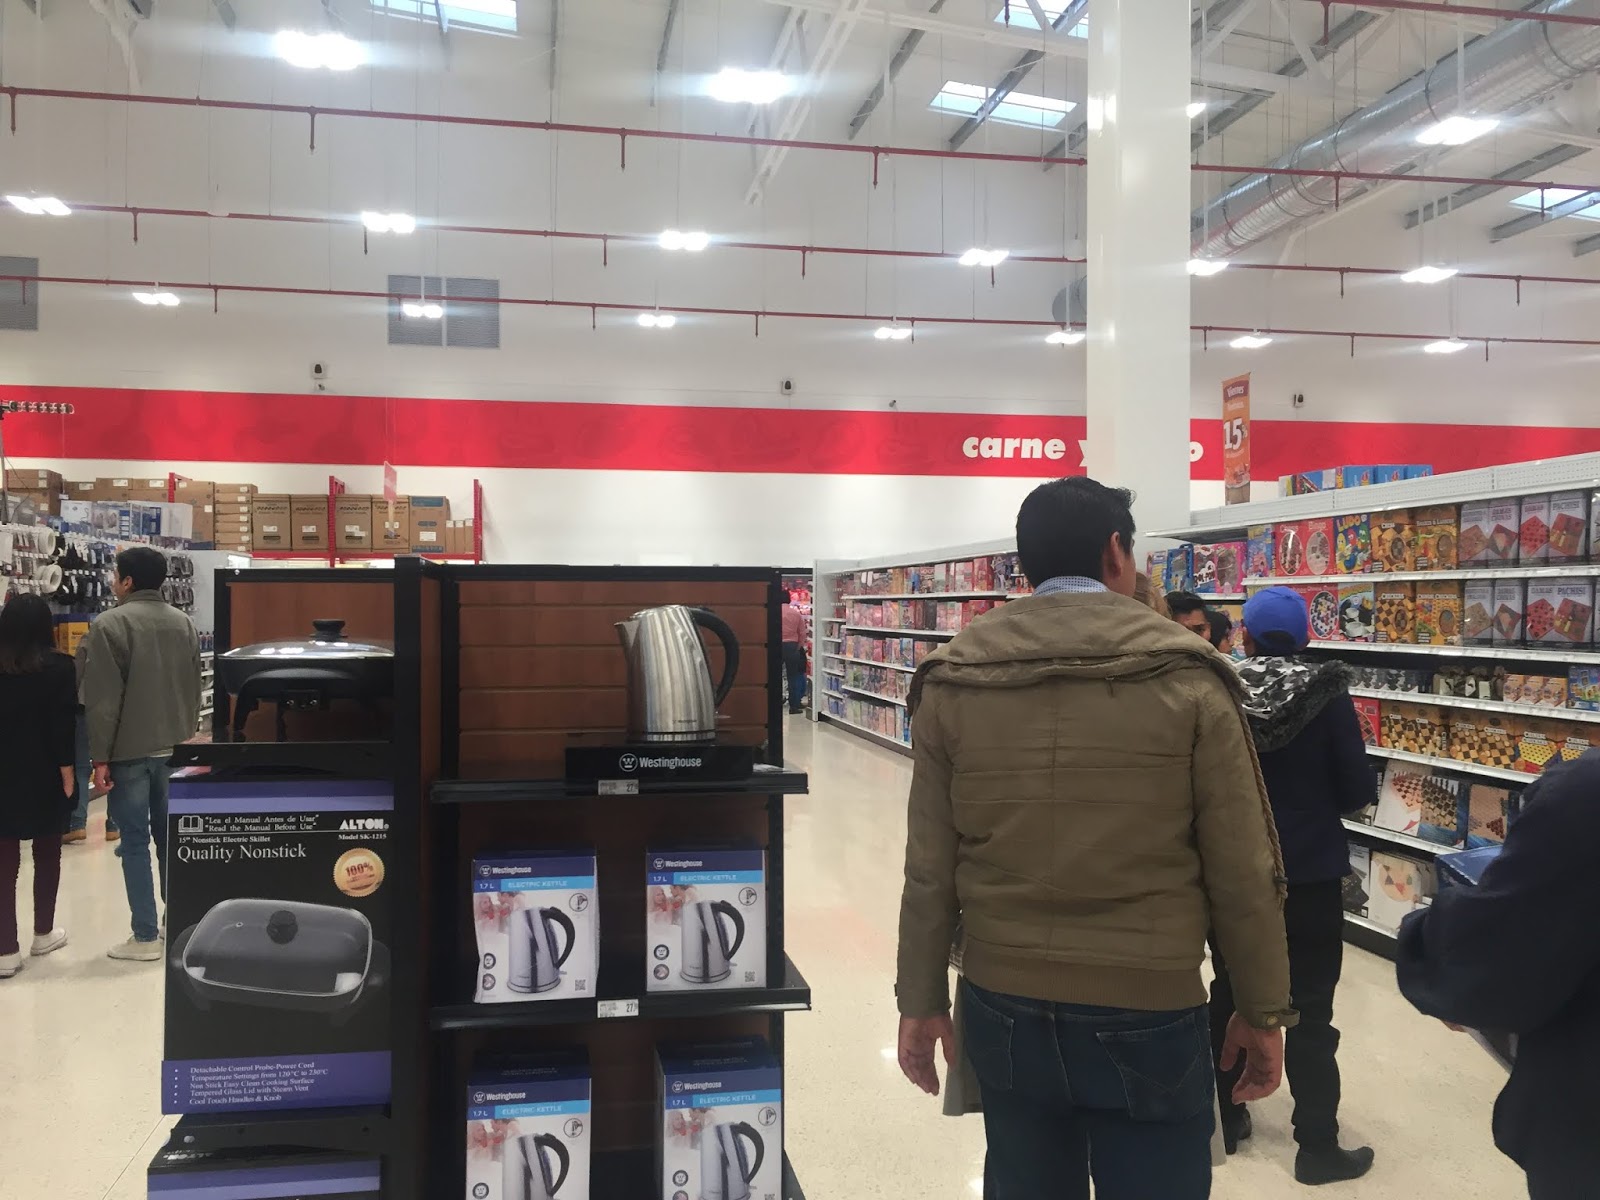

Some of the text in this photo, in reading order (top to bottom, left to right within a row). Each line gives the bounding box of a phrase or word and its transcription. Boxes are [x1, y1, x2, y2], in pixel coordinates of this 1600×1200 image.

[962, 436, 1066, 460] carne
[639, 757, 702, 770] Westinghouse
[234, 816, 261, 824] Manual
[264, 815, 284, 823] Antes
[286, 815, 297, 823] de
[229, 824, 241, 832] the
[244, 824, 271, 832] Manual
[274, 823, 297, 831] Before
[192, 836, 221, 844] Nonstick
[249, 835, 271, 843] Skillet
[177, 843, 307, 863] Quality Nonstick
[665, 860, 703, 869] Westinghouse
[491, 866, 532, 875] Westinghouse
[507, 881, 541, 889] ELECTRIC
[261, 1079, 288, 1087] Cooking
[684, 1082, 722, 1091] Westinghouse
[486, 1092, 526, 1101] Westinghouse
[732, 1094, 756, 1102] KETTLE
[502, 1105, 562, 1115] ELECTRIC KETTLE
